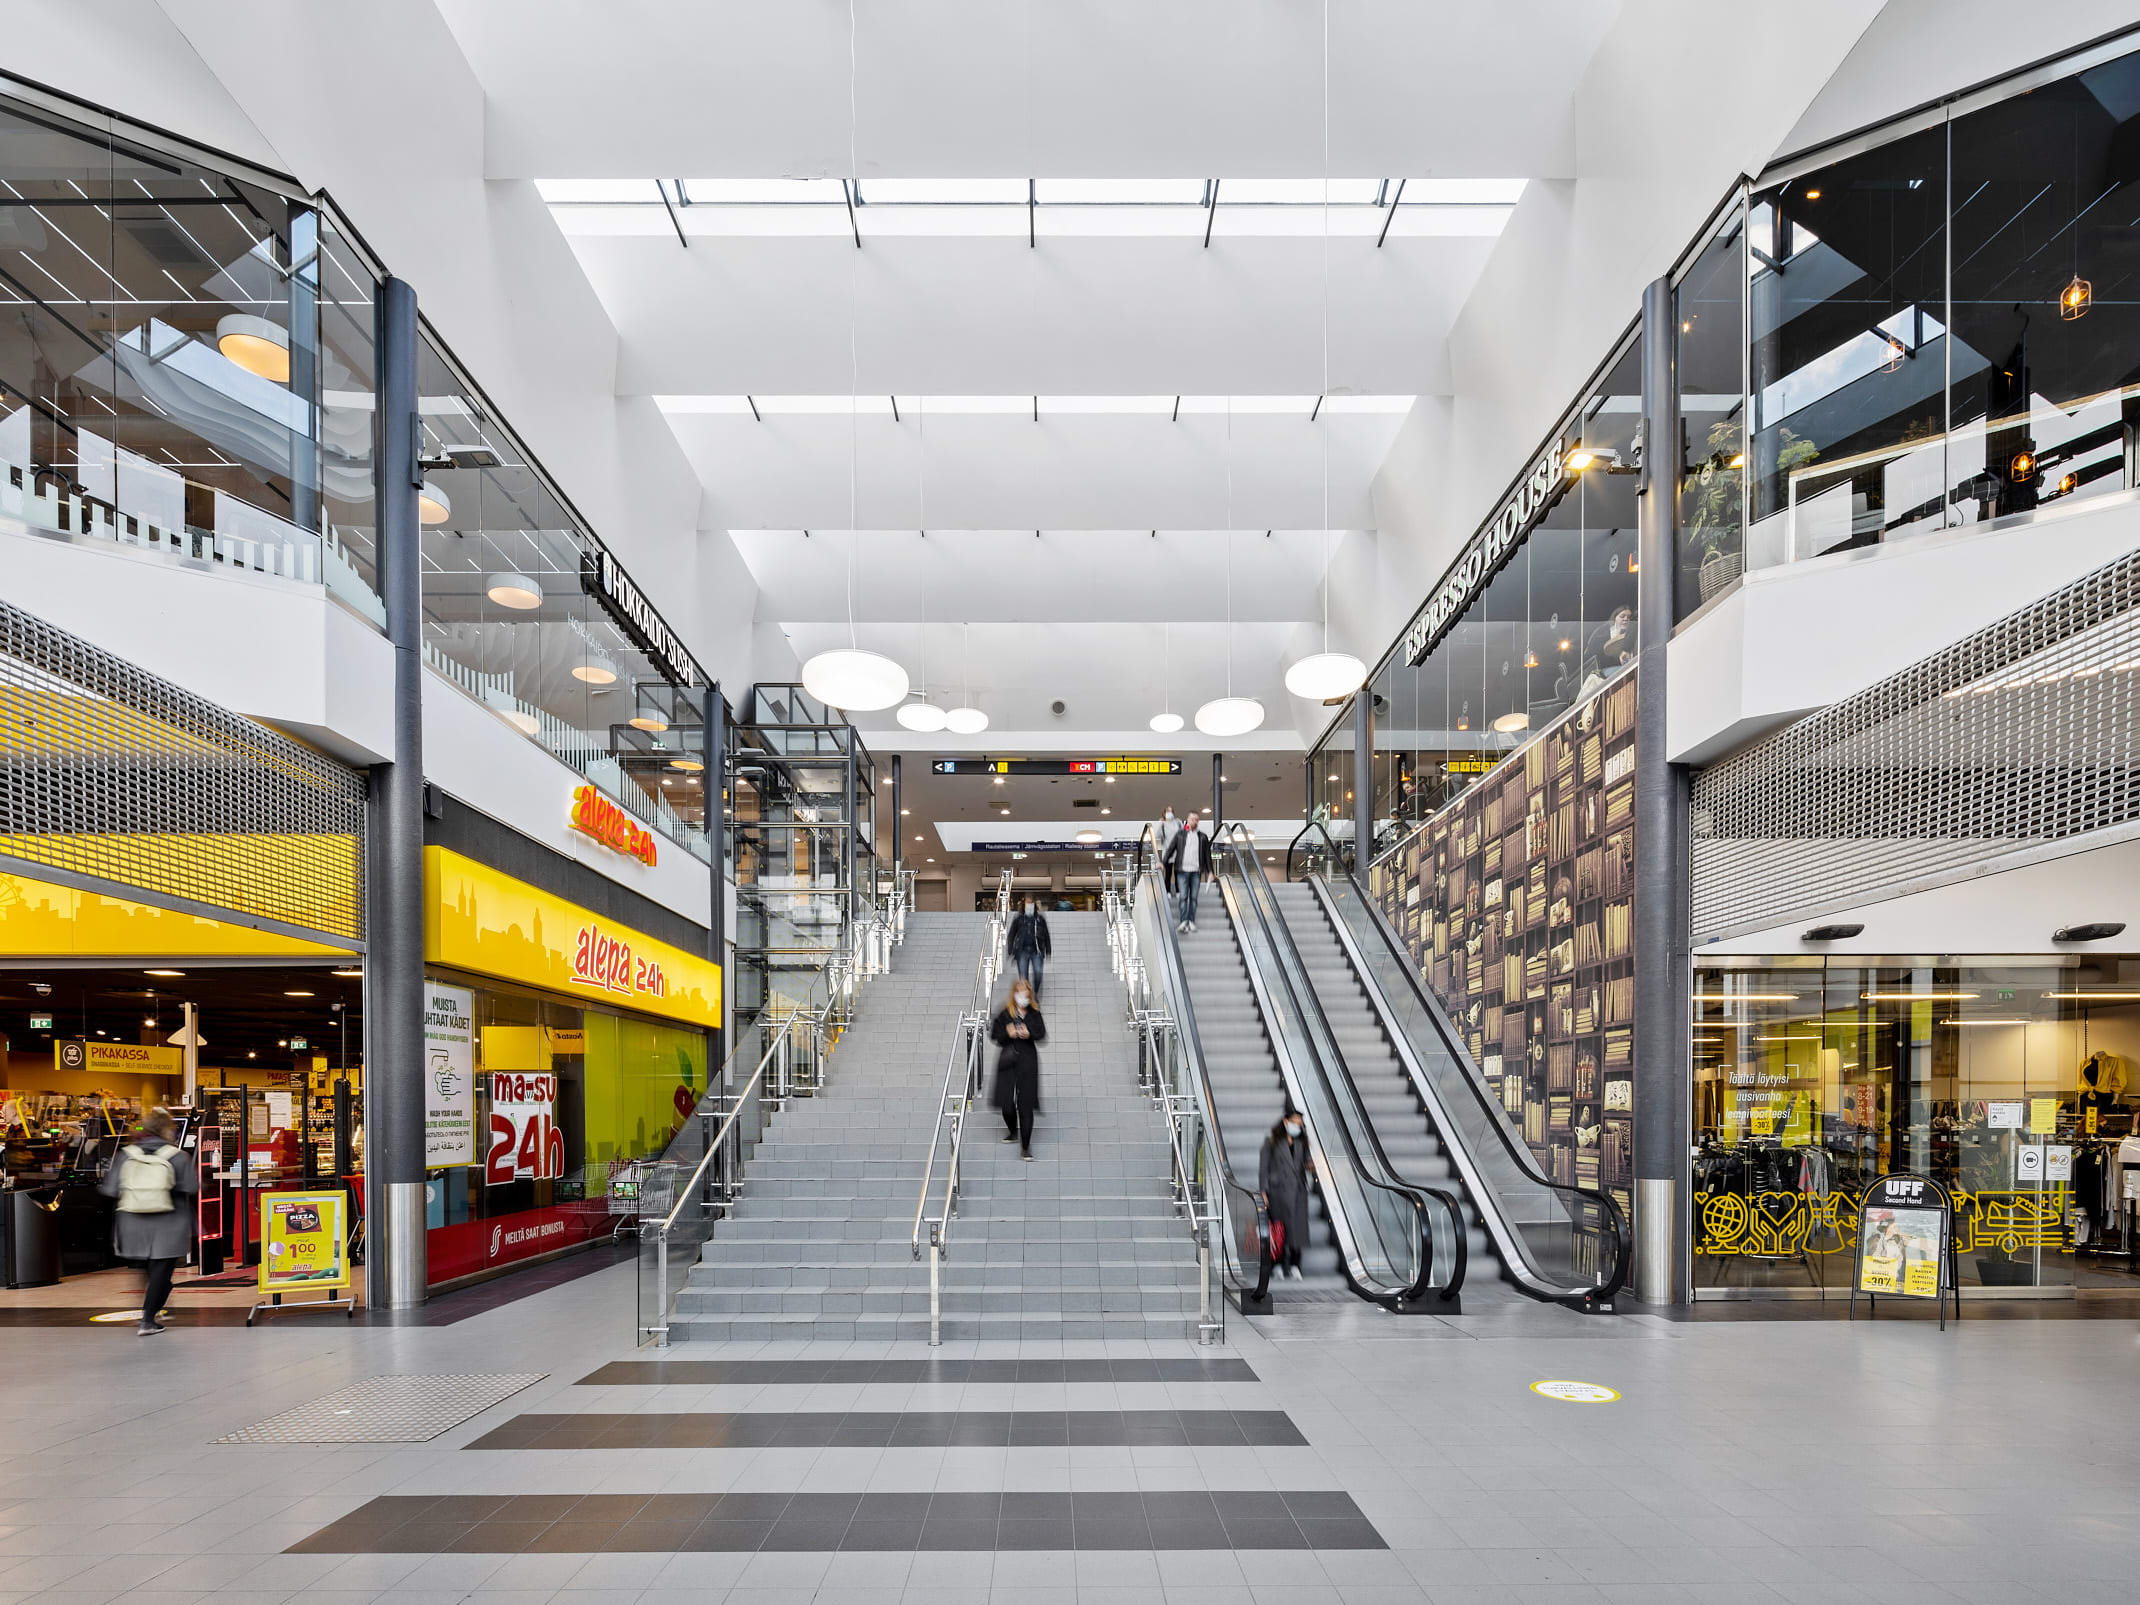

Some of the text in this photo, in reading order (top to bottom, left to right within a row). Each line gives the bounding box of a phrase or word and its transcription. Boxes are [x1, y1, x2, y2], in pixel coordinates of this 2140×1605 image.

[1405, 438, 1563, 668] ESPRESSO HOUSE
[612, 563, 694, 689] HOKKAIDO SUSHI
[569, 784, 657, 867] alepa 24h
[571, 923, 664, 998] alepa 24h
[432, 996, 457, 1012] MUISTA
[424, 1011, 470, 1030] UHTAAT KÄDET
[91, 1047, 150, 1061] PIKAKASSA
[494, 1072, 557, 1102] ma-su
[1757, 1071, 1790, 1087] löytyisi
[1736, 1089, 1782, 1102] uusivanha
[1725, 1106, 1792, 1122] lempivaatteesi.
[486, 1112, 564, 1186] 24h
[1885, 1180, 1924, 1196] UFF
[1884, 1195, 1922, 1205] Second Hand
[505, 1220, 565, 1245] MEILTÄ SAAT BONUSTA
